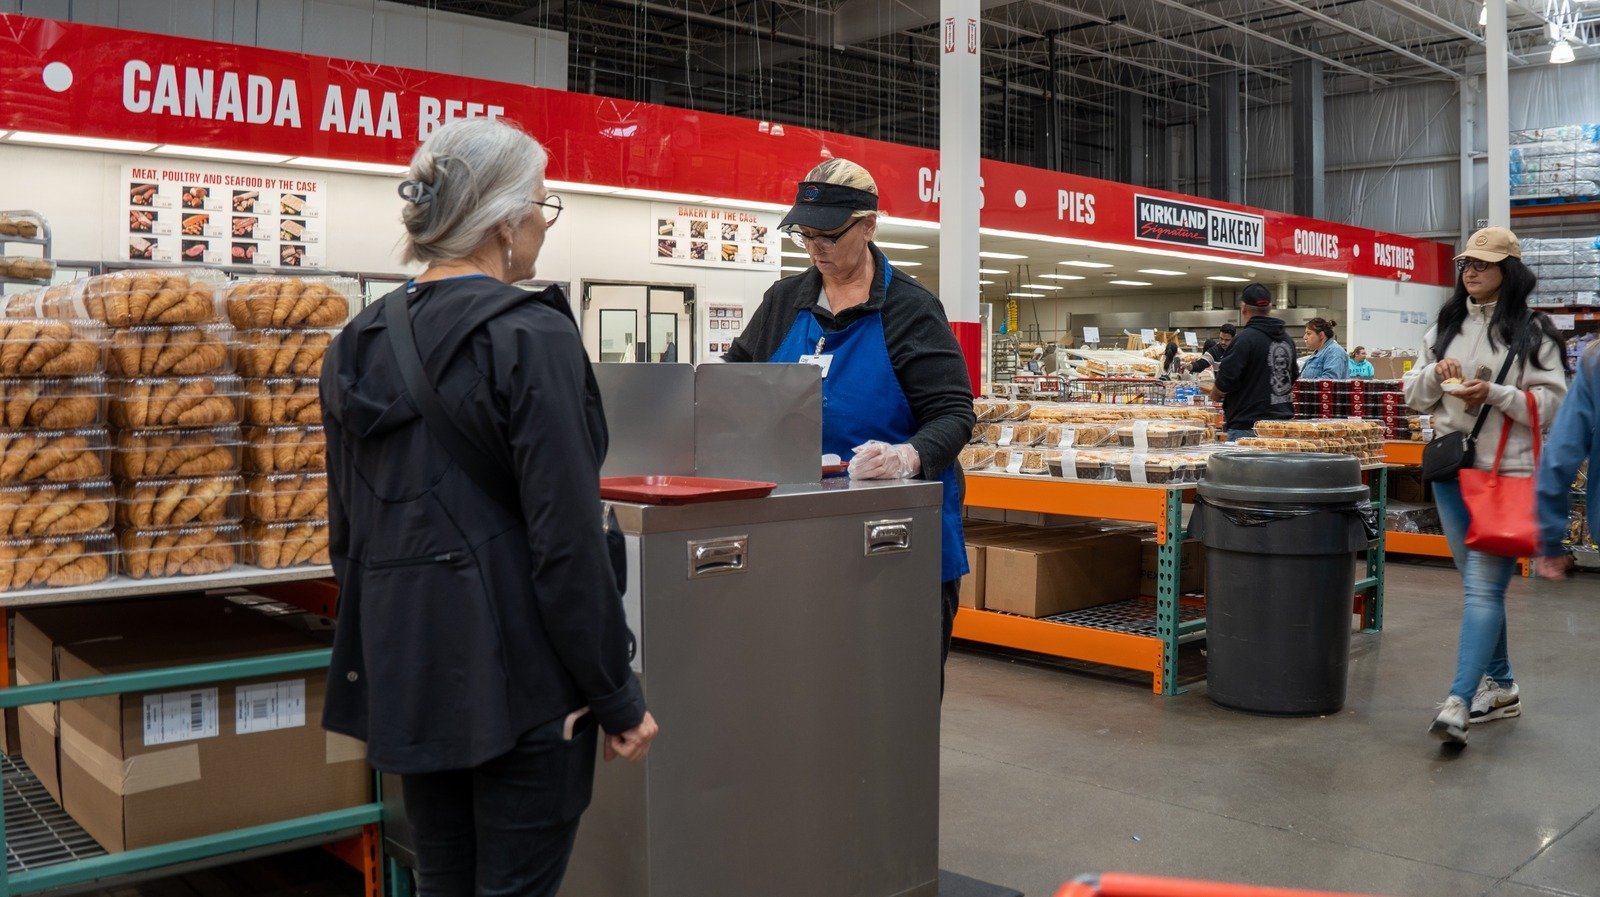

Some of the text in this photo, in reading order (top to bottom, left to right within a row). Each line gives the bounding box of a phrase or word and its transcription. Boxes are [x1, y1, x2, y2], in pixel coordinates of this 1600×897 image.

[122, 59, 302, 129] CANADA
[319, 84, 402, 140] AAA
[132, 168, 317, 192] MEAT, POULTRY AND SEAFOOD BY THE CASE
[678, 206, 758, 224] BAKERY BY THE CASE
[1058, 189, 1096, 225] PIES
[1140, 202, 1206, 230] KIRKLAND
[1141, 221, 1206, 240] Signature
[1211, 214, 1259, 248] BAKERY
[1294, 228, 1339, 260] COOKIES
[1374, 242, 1415, 271] PASTRIES
